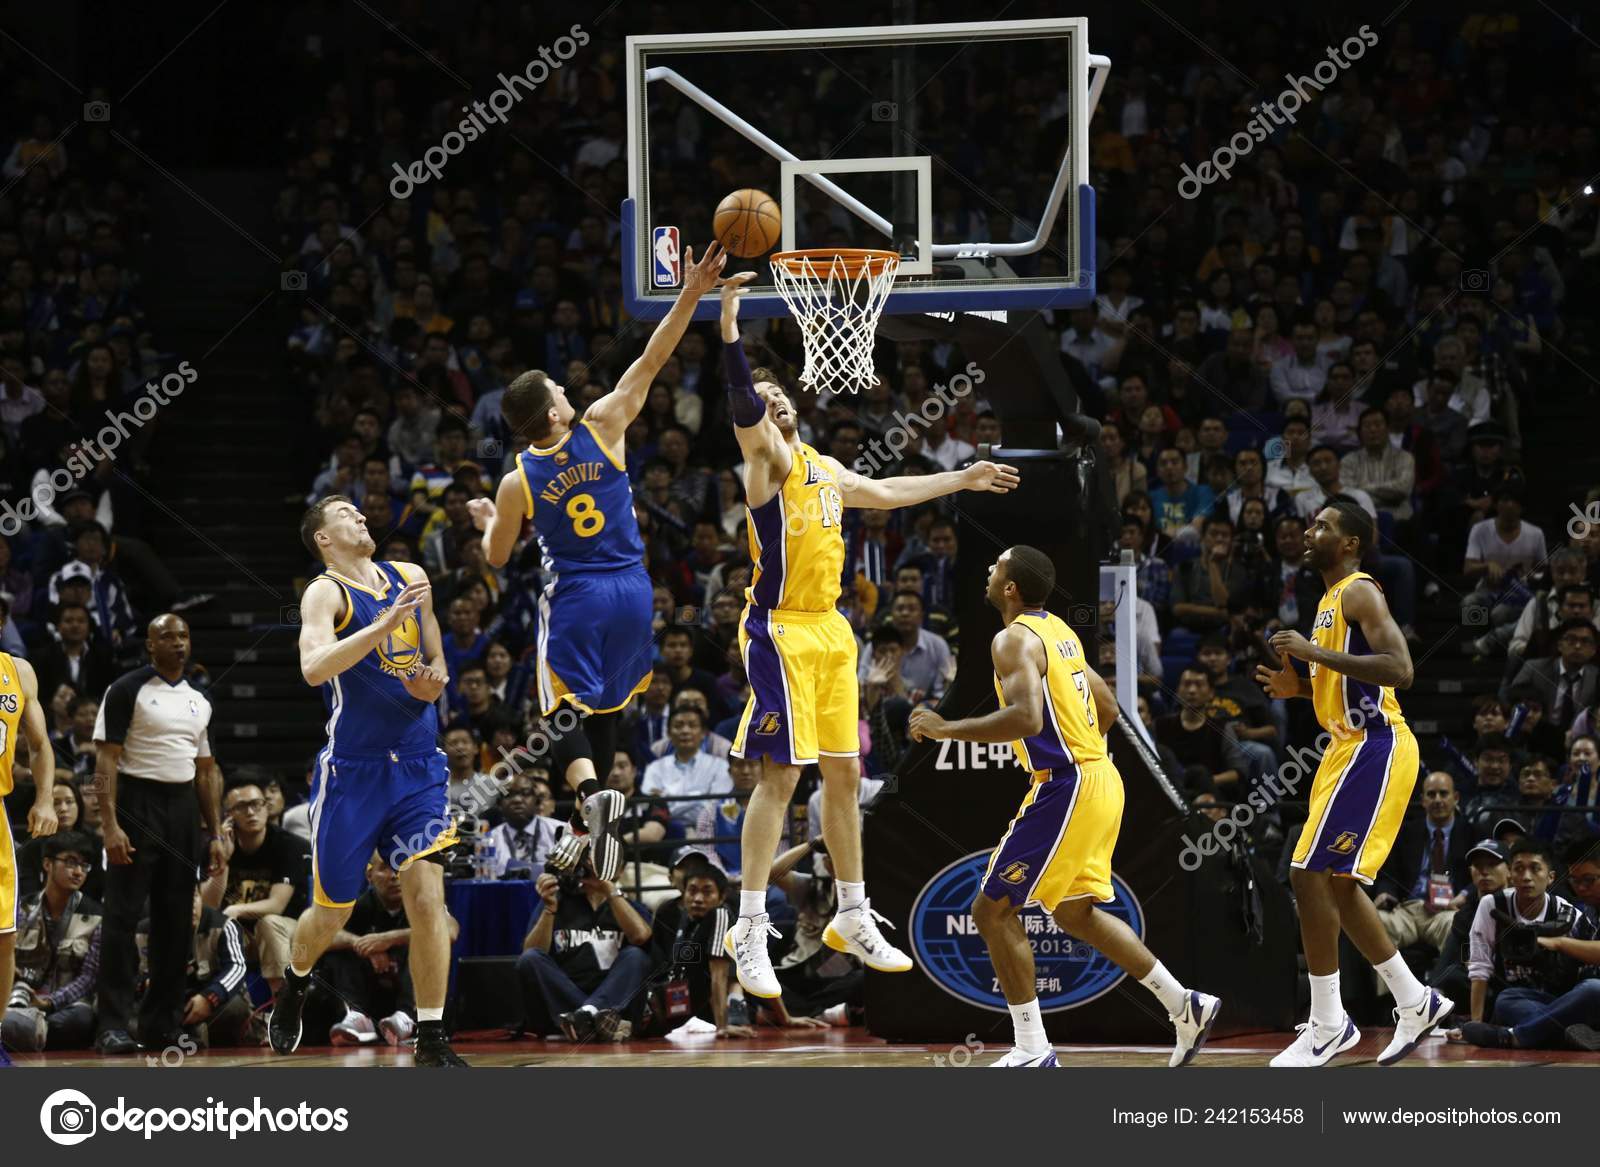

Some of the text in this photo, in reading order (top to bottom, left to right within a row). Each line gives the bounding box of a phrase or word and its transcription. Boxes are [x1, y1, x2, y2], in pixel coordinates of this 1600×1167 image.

[657, 274, 672, 283] NBA
[540, 462, 604, 504] NEDOVIC
[566, 493, 605, 538] 8
[1071, 669, 1095, 728] 7
[1030, 939, 1073, 953] 2013
